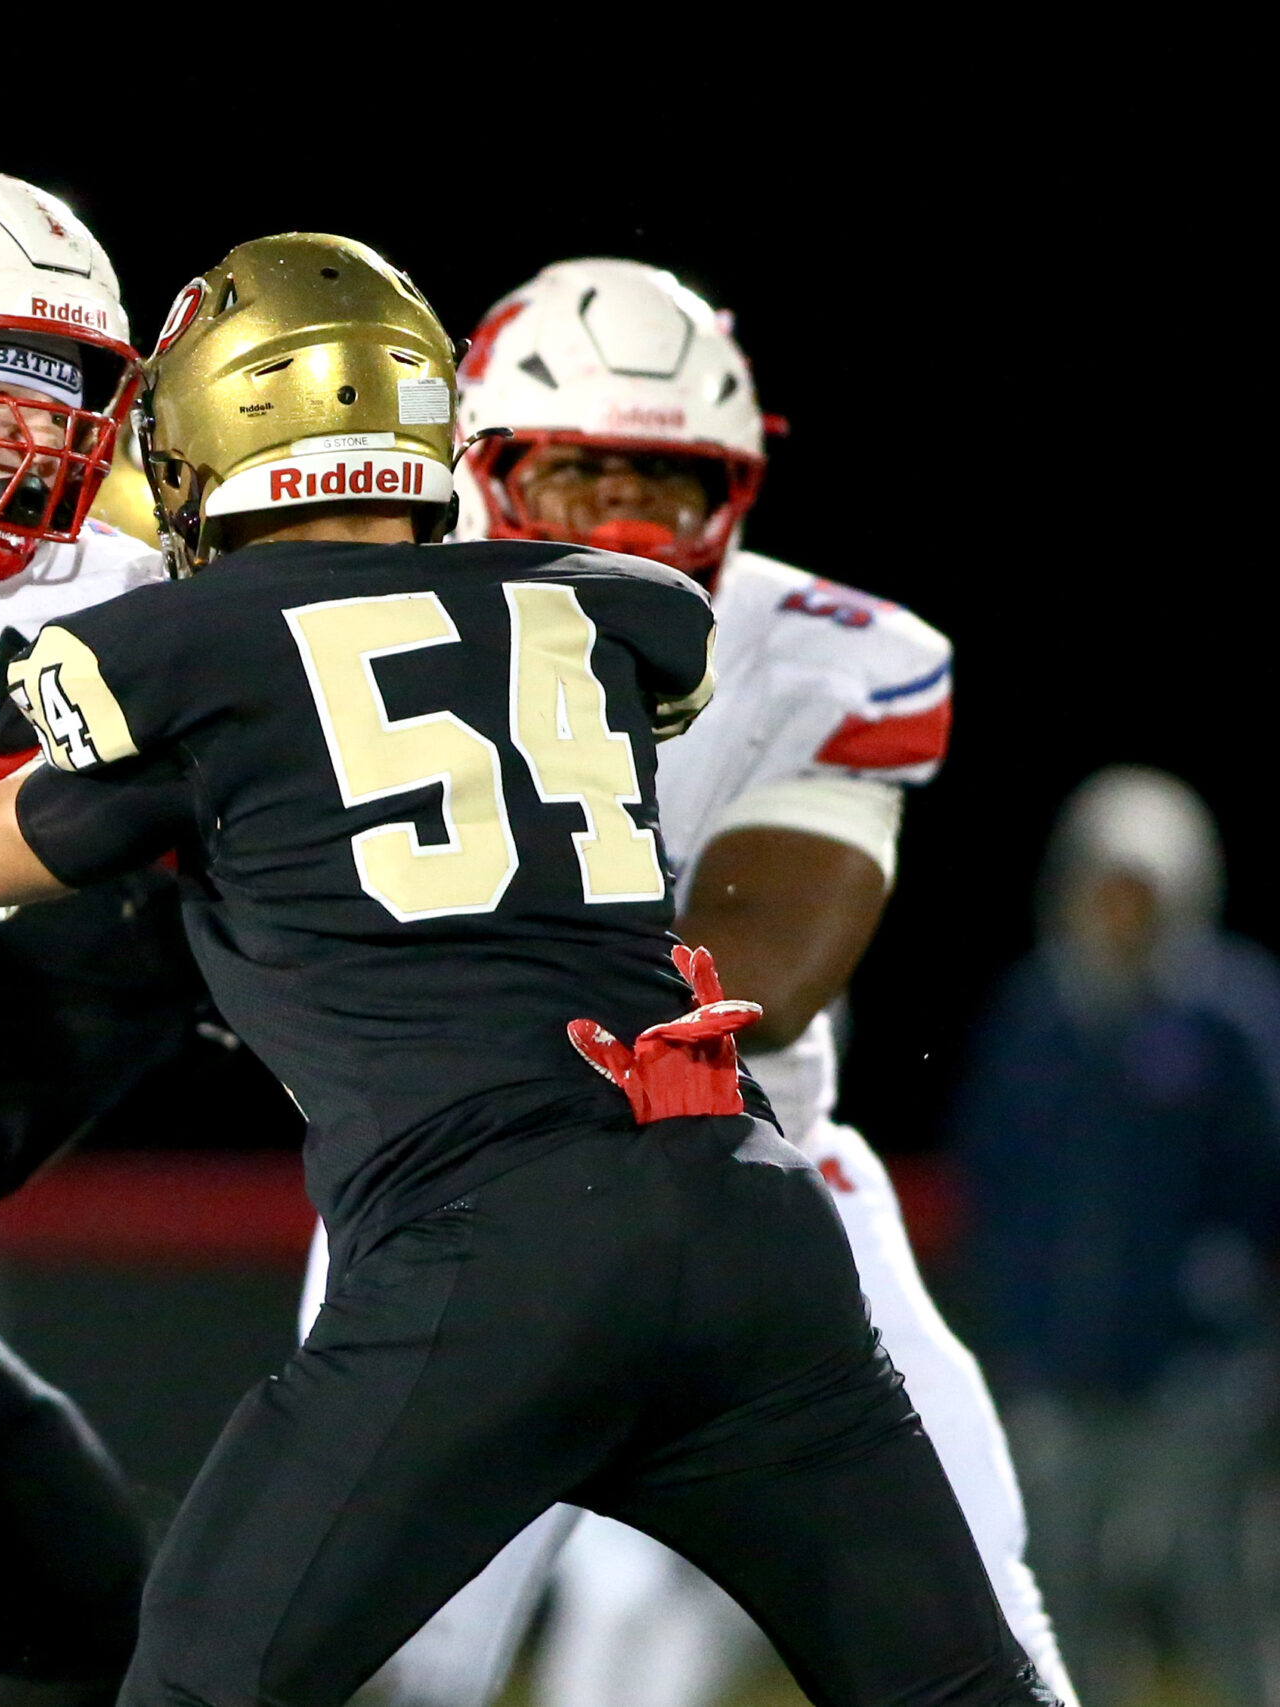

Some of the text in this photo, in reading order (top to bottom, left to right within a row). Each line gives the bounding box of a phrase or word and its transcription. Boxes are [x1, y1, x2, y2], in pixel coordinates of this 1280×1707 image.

[31, 297, 107, 330] Riddell
[323, 437, 369, 448] G STONE
[270, 461, 424, 501] Riddell
[282, 582, 665, 922] 54
